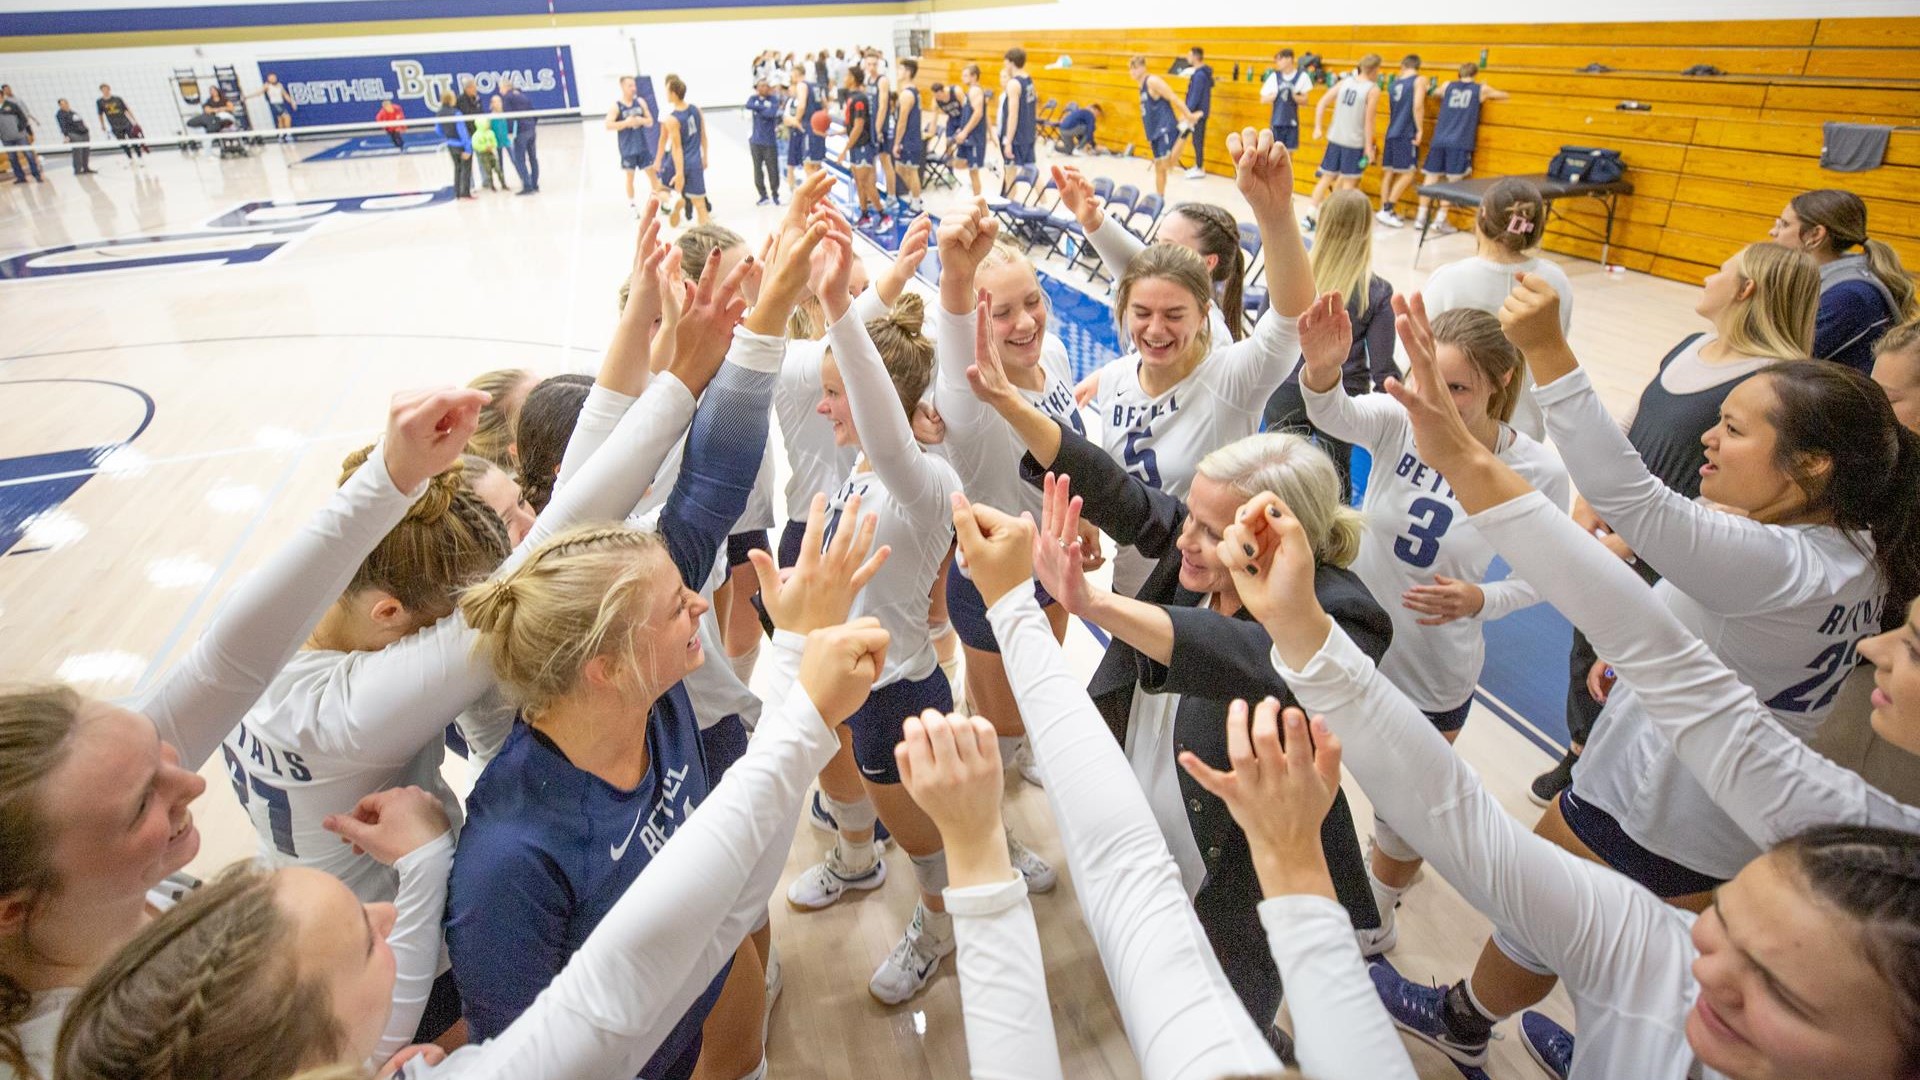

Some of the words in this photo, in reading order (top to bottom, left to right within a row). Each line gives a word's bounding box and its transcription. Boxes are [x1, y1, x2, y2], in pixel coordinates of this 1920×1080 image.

[288, 77, 394, 105] BETHEL
[391, 59, 454, 113] BU
[1342, 88, 1358, 107] 10
[1448, 88, 1473, 109] 20
[1124, 426, 1163, 490] 5
[1395, 452, 1456, 500] BET
[1393, 497, 1454, 569] 3
